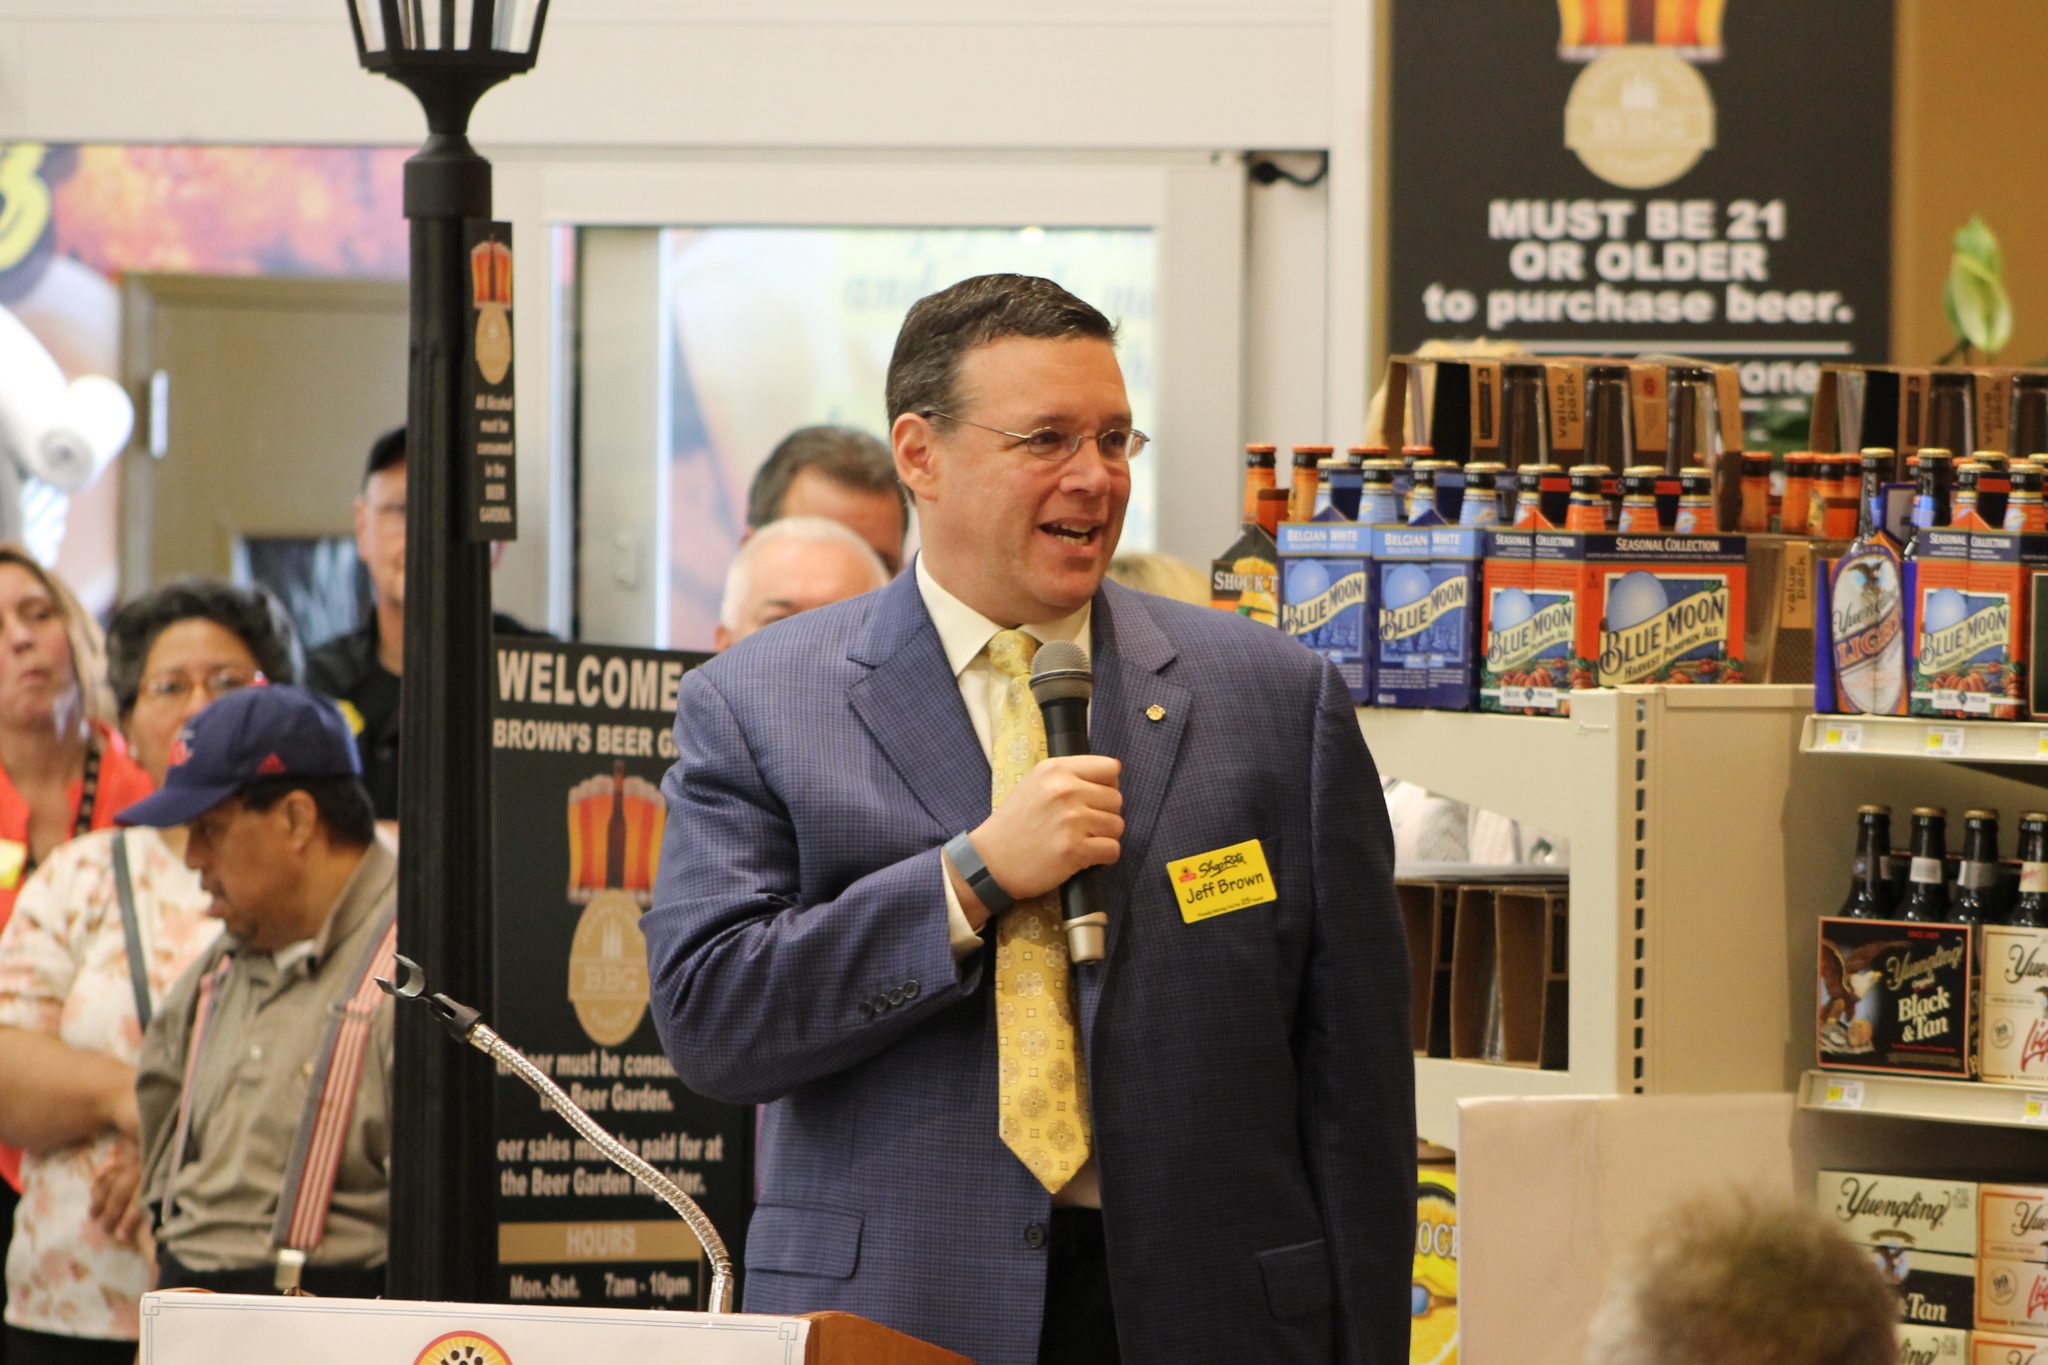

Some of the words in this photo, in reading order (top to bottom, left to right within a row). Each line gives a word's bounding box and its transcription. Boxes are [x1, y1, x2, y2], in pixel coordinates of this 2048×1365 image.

[1488, 202, 1634, 240] MUST
[1646, 202, 1716, 240] BE
[1726, 202, 1787, 240] 21
[1509, 243, 1585, 281] OR
[1595, 243, 1768, 282] OLDER
[1423, 284, 1477, 322] to
[1487, 284, 1714, 330] purchase
[1725, 284, 1854, 323] beer.
[1557, 384, 1568, 438] value
[1566, 372, 1579, 422] pack
[1286, 528, 1326, 543] BELGIAN
[1329, 529, 1359, 543] WHITE
[1384, 532, 1428, 547] BELGIAN
[1431, 531, 1462, 546] WHITE
[1495, 532, 1531, 547] SEASONAL
[1534, 533, 1576, 548] COLLECTION
[1615, 536, 1665, 552] SEASONAL
[1664, 539, 1720, 553] COLLECTION
[1929, 532, 1967, 546] SEASONAL
[1970, 535, 2011, 550] COLLECTION
[1284, 599, 1328, 637] BLUE
[1329, 577, 1363, 613] MOON
[1380, 602, 1428, 641] BLUE
[1429, 581, 1465, 616] MOON
[1488, 626, 1530, 664] BLUE
[1532, 606, 1572, 640] MOON
[1600, 621, 1662, 675] BLUE
[1665, 594, 1725, 641] MOON
[1920, 628, 1963, 667] BLUE
[1966, 609, 2008, 643] MOON
[498, 650, 683, 711] WELCOME
[493, 719, 591, 754] BROWN'S
[596, 725, 653, 757] BEER
[1186, 882, 1214, 904] Jeff
[1217, 872, 1265, 895] Brown
[1898, 986, 1950, 1022] Black
[556, 1049, 597, 1077] must
[600, 1049, 620, 1078] be
[611, 1082, 674, 1112] Garden.
[527, 1132, 571, 1161] sales
[641, 1132, 677, 1164] paid
[679, 1131, 702, 1160] for
[704, 1132, 723, 1161] at
[501, 1169, 527, 1196] the
[532, 1168, 569, 1196] Beer
[573, 1167, 631, 1196] Garden
[1837, 1177, 1950, 1230] Yuengling
[566, 1227, 635, 1255] HOURS
[604, 1272, 637, 1297] 7am
[650, 1271, 691, 1300] 10pm
[1907, 1292, 1946, 1322] Tan
